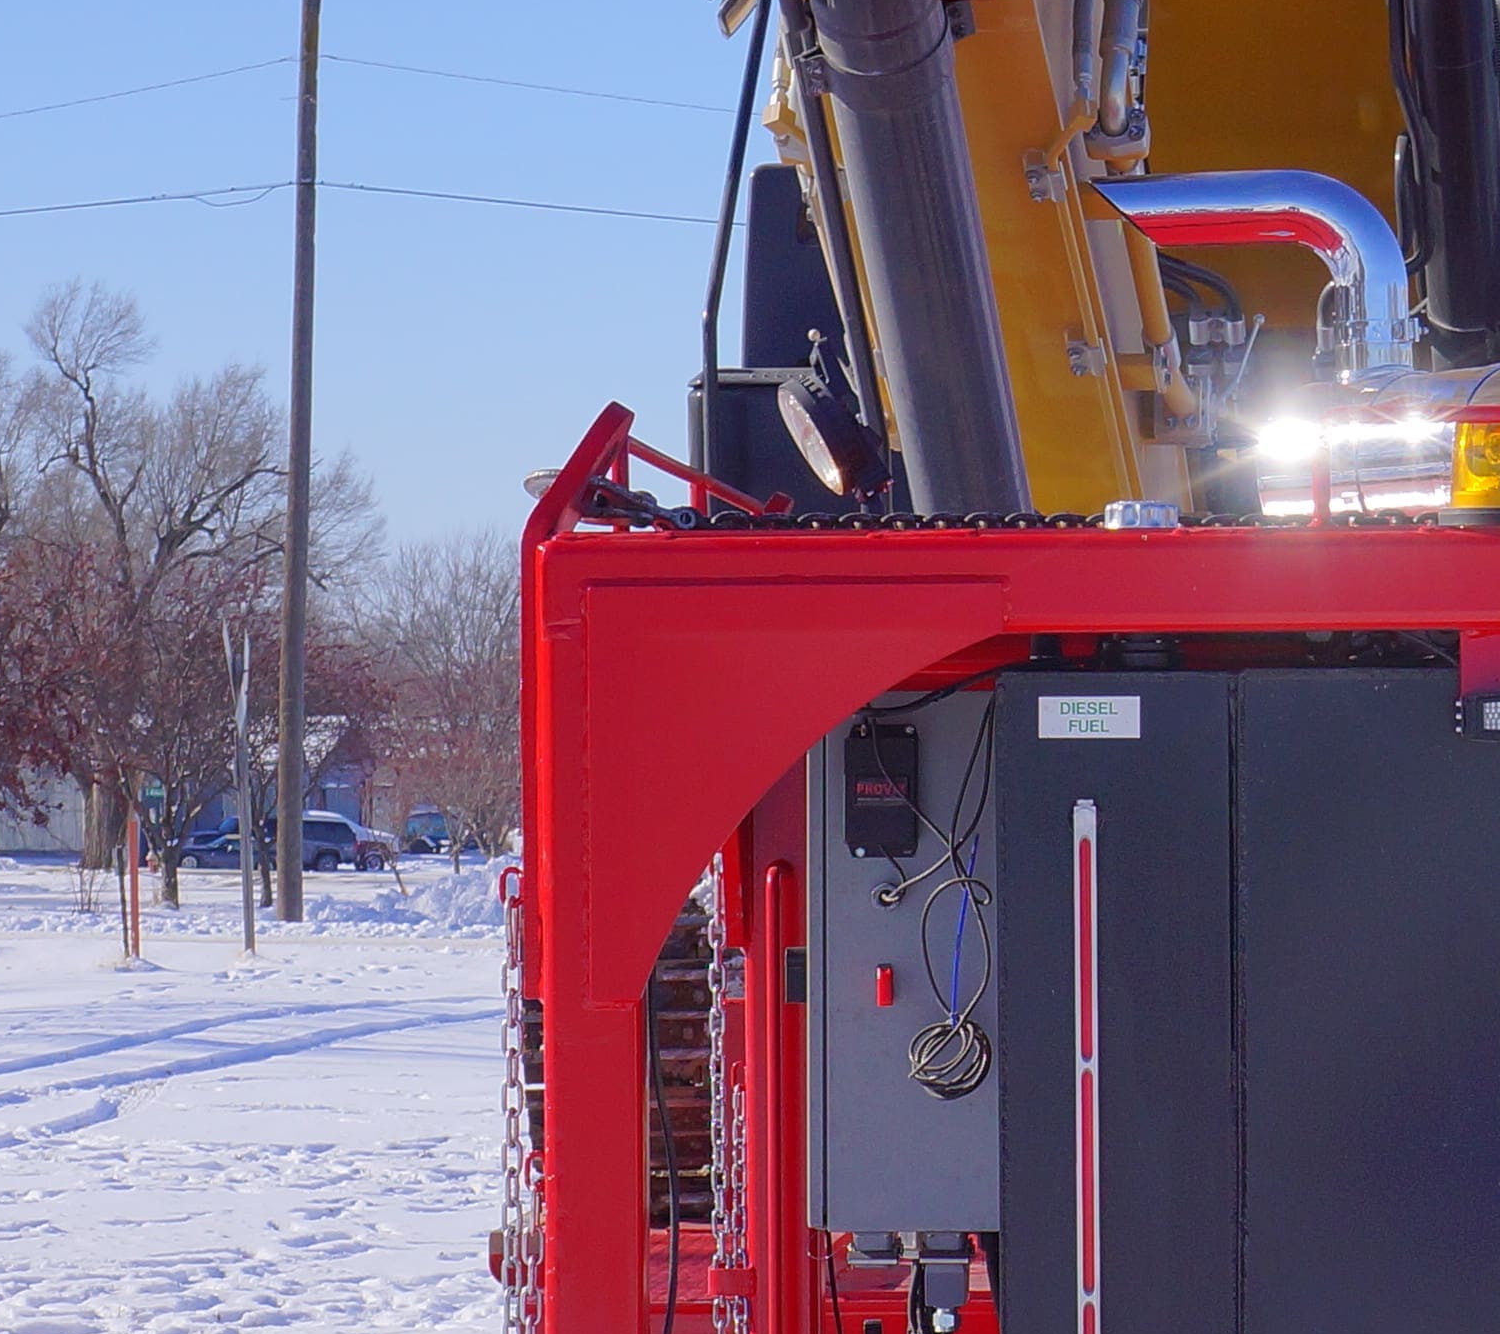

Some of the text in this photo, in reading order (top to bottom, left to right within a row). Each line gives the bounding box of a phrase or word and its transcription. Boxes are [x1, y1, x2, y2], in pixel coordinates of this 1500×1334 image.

[1060, 701, 1119, 716] DIESEL
[1068, 719, 1110, 733] FUEL
[856, 782, 908, 796] PROVX
